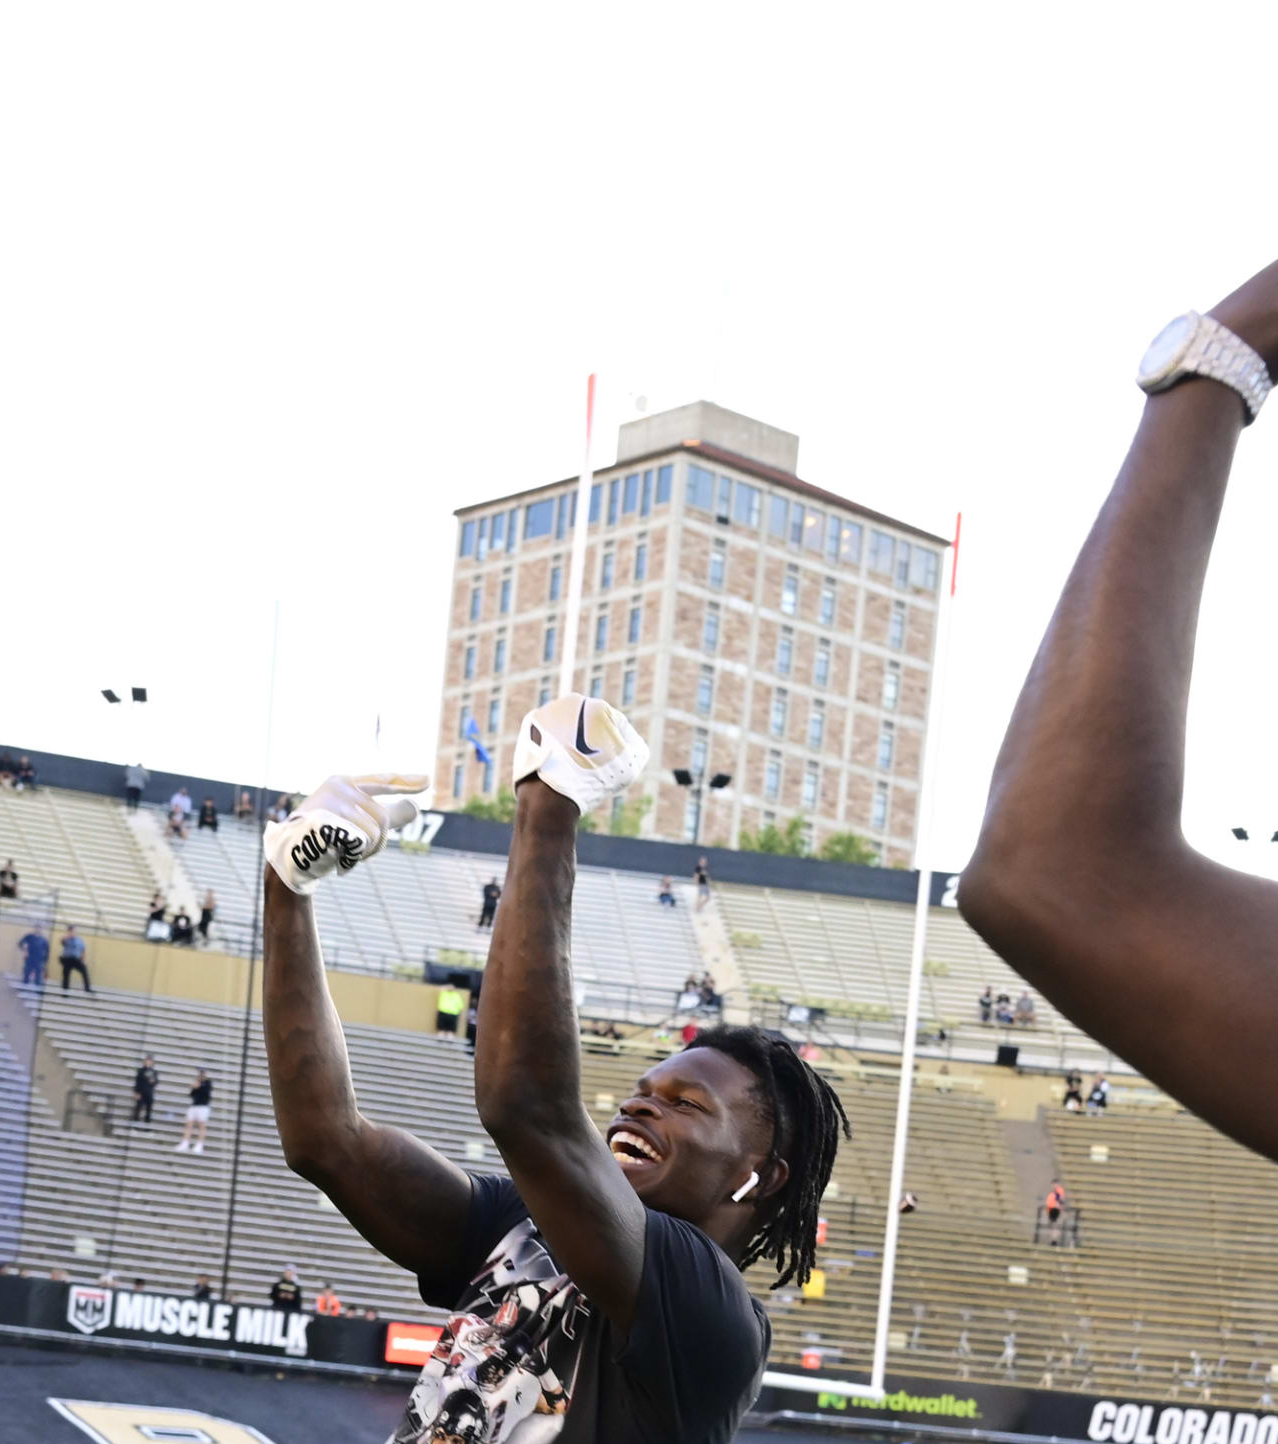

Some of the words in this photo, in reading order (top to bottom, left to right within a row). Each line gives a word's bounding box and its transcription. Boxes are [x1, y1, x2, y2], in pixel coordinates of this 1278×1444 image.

[386, 812, 444, 844] 07
[114, 1292, 233, 1341] MUSCLE
[235, 1307, 310, 1348] MILK
